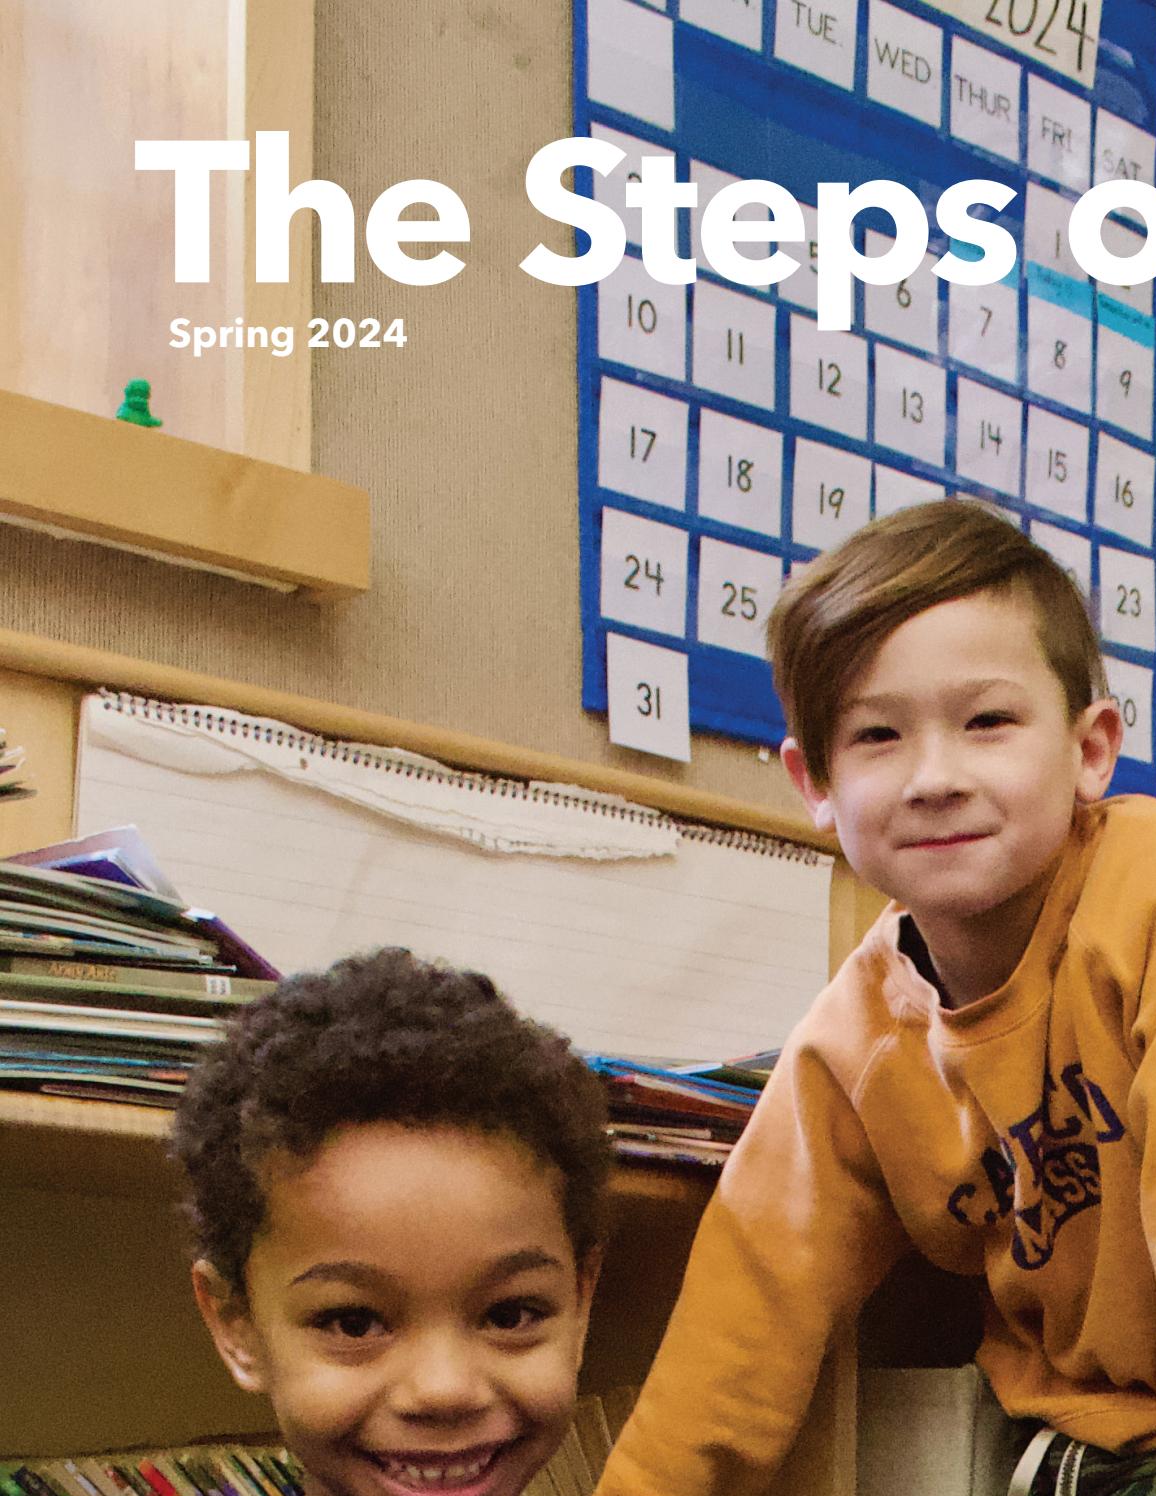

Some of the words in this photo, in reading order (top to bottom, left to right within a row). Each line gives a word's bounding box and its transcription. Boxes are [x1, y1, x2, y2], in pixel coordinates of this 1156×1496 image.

[979, 306, 993, 337] 7
[1053, 340, 1067, 370] 8
[1119, 370, 1132, 398] 9
[628, 294, 656, 335] 10
[727, 328, 744, 365] 11
[818, 358, 842, 397] 12
[901, 388, 924, 424] 13
[980, 420, 1003, 455] 14
[1048, 448, 1068, 482] 15
[1116, 474, 1134, 509] 16
[631, 426, 657, 463] 17
[727, 455, 755, 493] 18
[819, 483, 845, 519] 19
[1117, 584, 1142, 618] 23
[624, 555, 664, 596] 24
[721, 582, 758, 622] 25
[637, 683, 661, 720] 31
